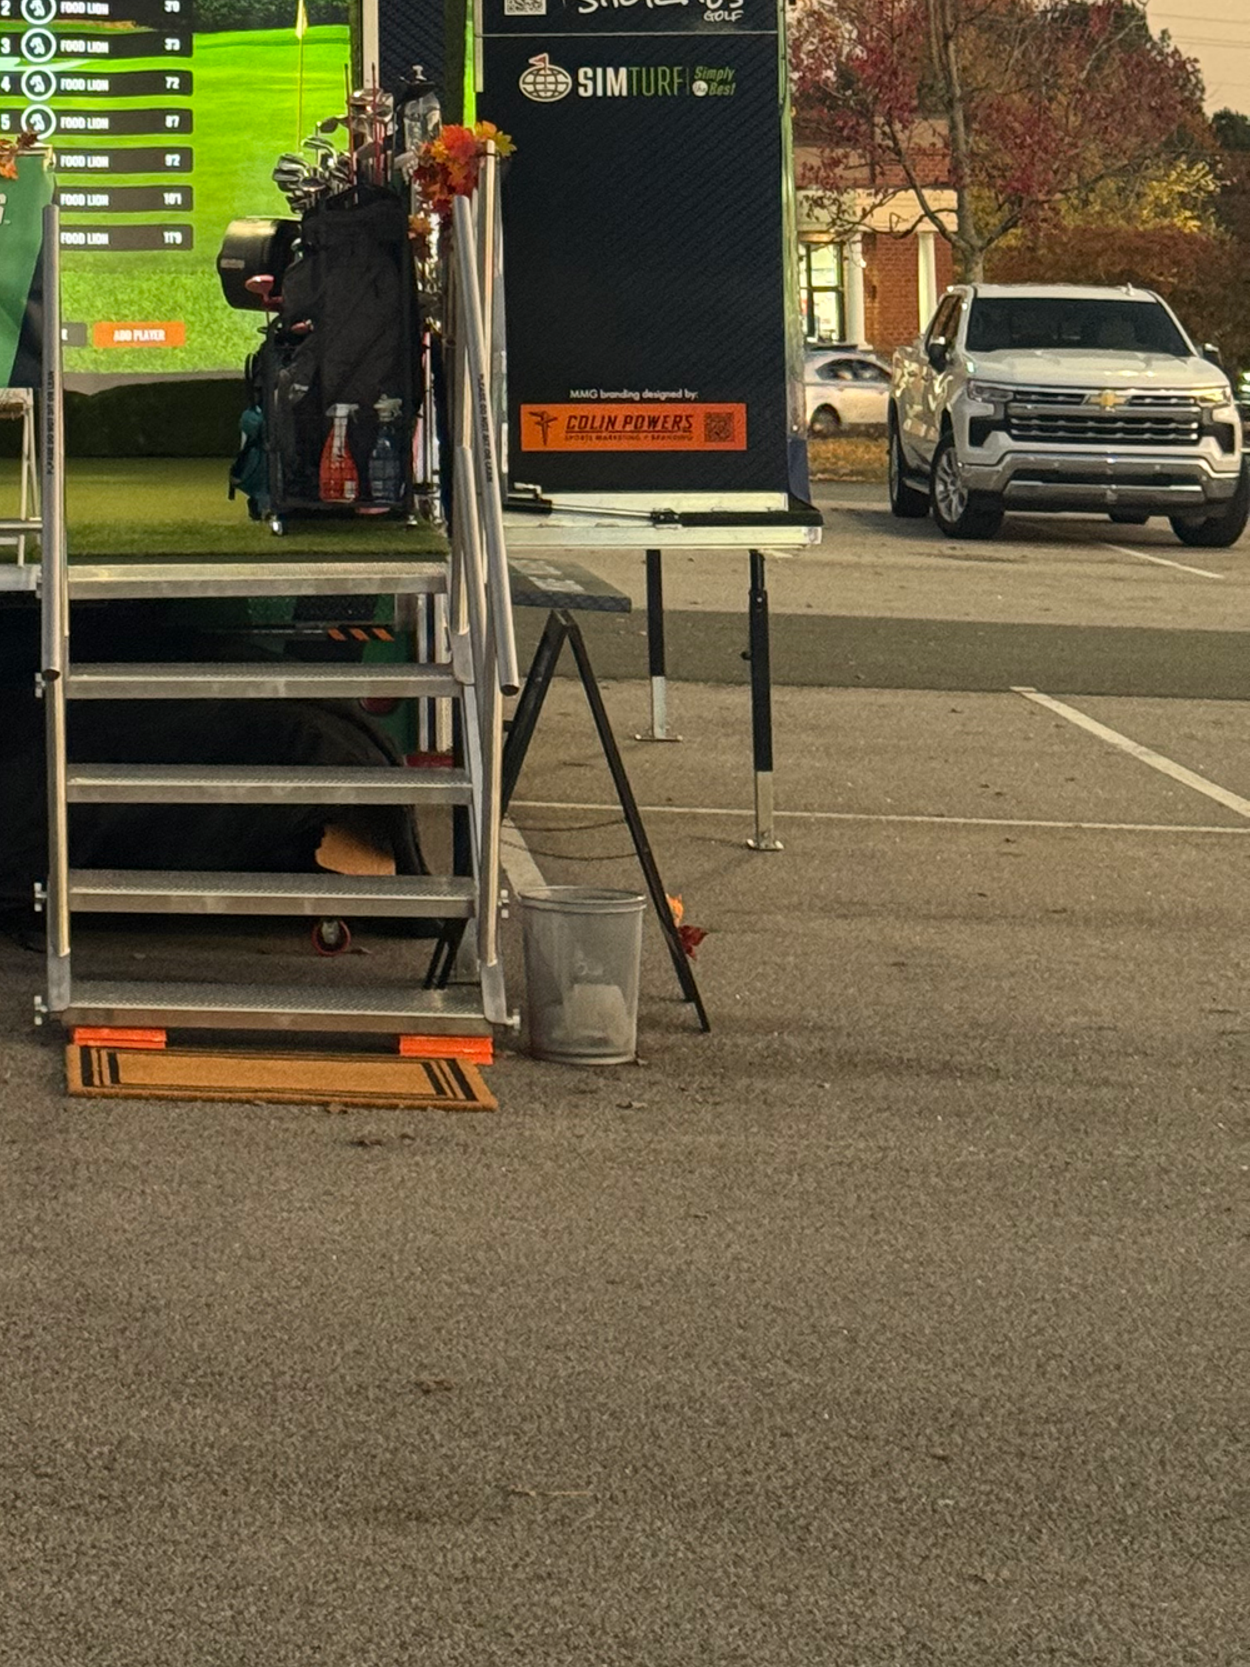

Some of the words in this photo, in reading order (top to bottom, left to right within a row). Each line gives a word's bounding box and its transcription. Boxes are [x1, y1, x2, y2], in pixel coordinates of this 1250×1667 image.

[1, 0, 10, 16] 2
[60, 0, 86, 14] FOOD
[86, 2, 109, 16] LION
[704, 10, 744, 22] GOLF
[1, 38, 10, 54] 3
[60, 39, 86, 52] FOOD
[86, 40, 109, 54] LION
[578, 66, 683, 98] SIMTURF
[694, 66, 734, 82] Simply
[1, 76, 10, 92] 4
[60, 78, 86, 91] FOOD
[86, 78, 109, 92] LION
[708, 82, 736, 96] Best
[1, 114, 10, 130] 5
[60, 116, 86, 129] FOOD
[86, 116, 109, 130] LION
[60, 154, 86, 168] FOOD
[86, 156, 109, 168] LION
[60, 194, 86, 206] FOOD
[87, 194, 109, 206] LION
[60, 232, 86, 244] FOOD
[87, 232, 109, 245] LION
[570, 390, 598, 399] MMG
[600, 389, 640, 400] branding
[642, 389, 684, 400] designed
[685, 389, 698, 400] by:
[566, 415, 617, 432] COLIN
[622, 414, 694, 432] POWERS
